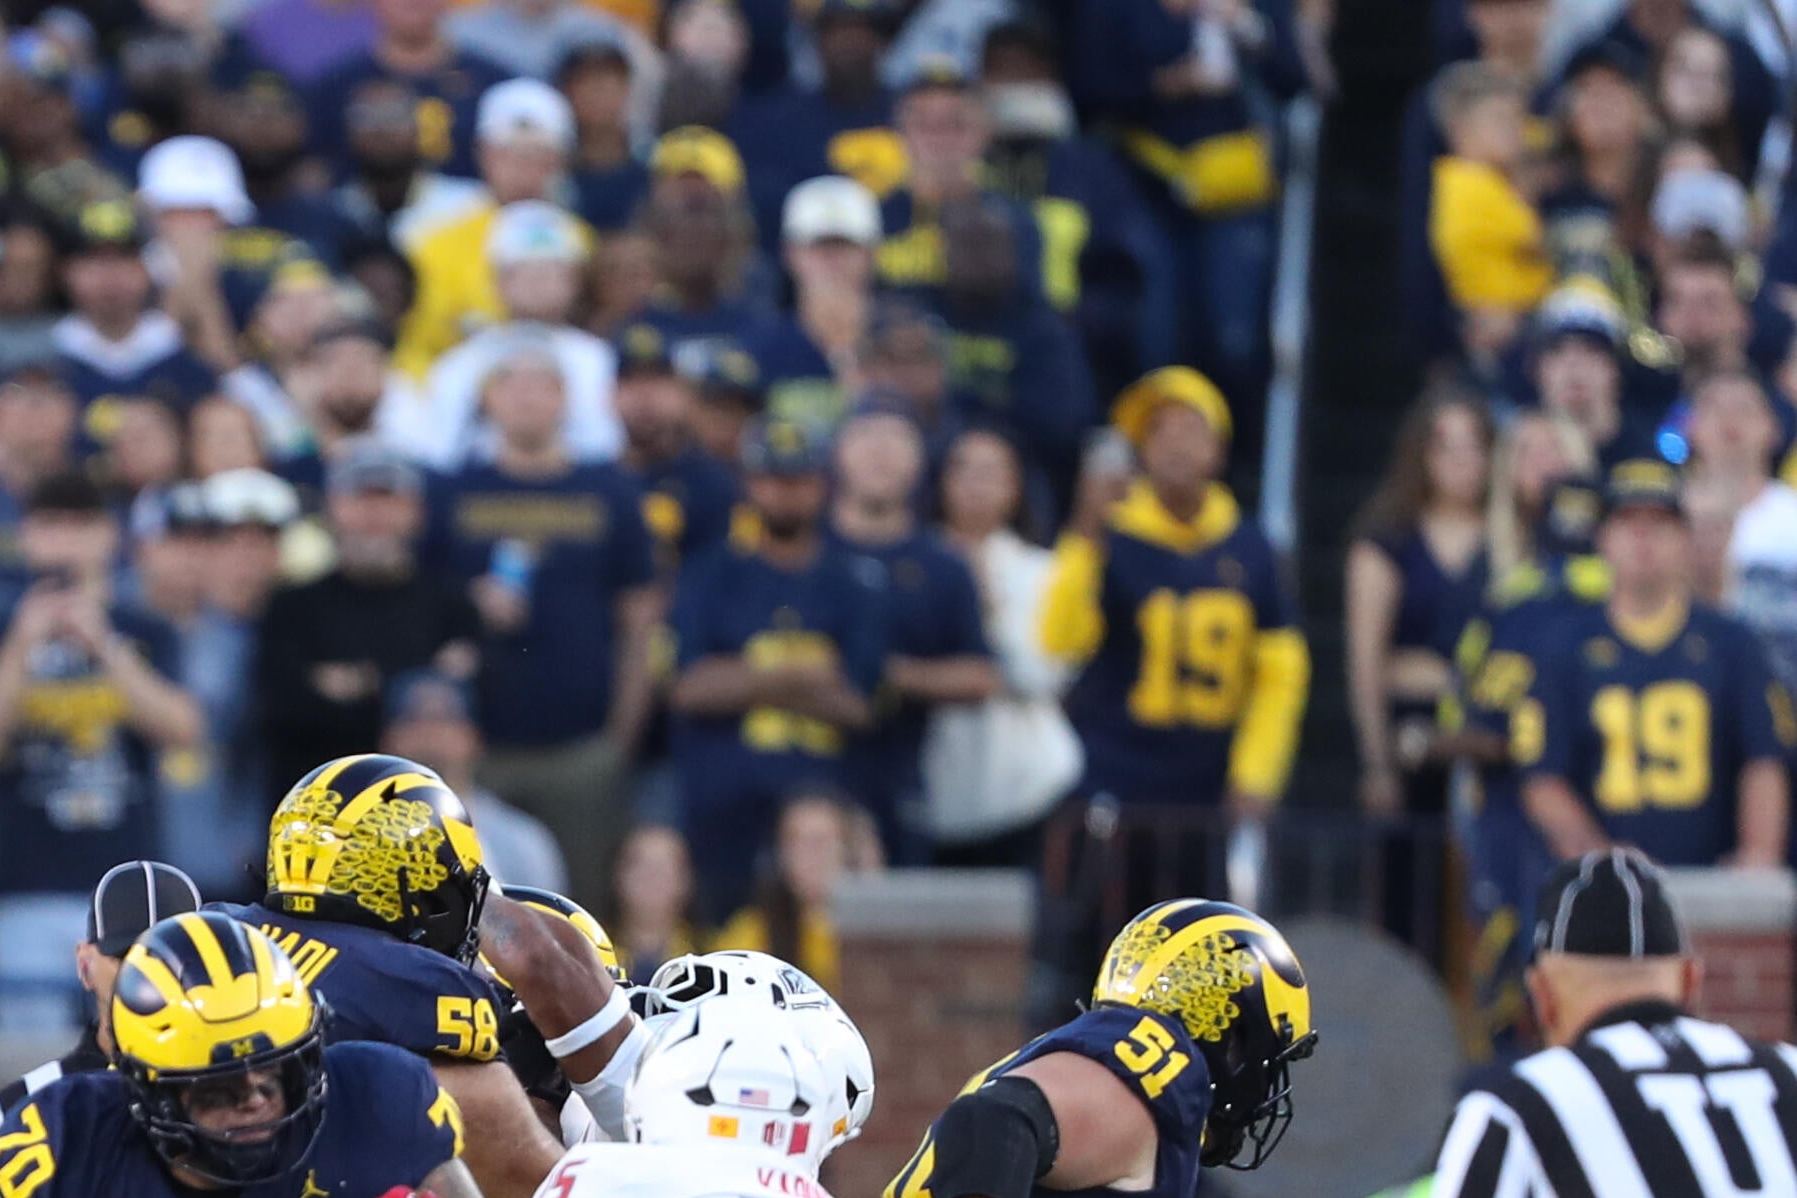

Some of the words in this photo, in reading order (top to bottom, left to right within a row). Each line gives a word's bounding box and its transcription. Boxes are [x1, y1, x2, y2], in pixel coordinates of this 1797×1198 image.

[1126, 587, 1254, 730] 19
[1590, 679, 1711, 813] 19
[232, 1040, 254, 1057] M
[434, 996, 500, 1061] 58
[1114, 1015, 1190, 1099] 51
